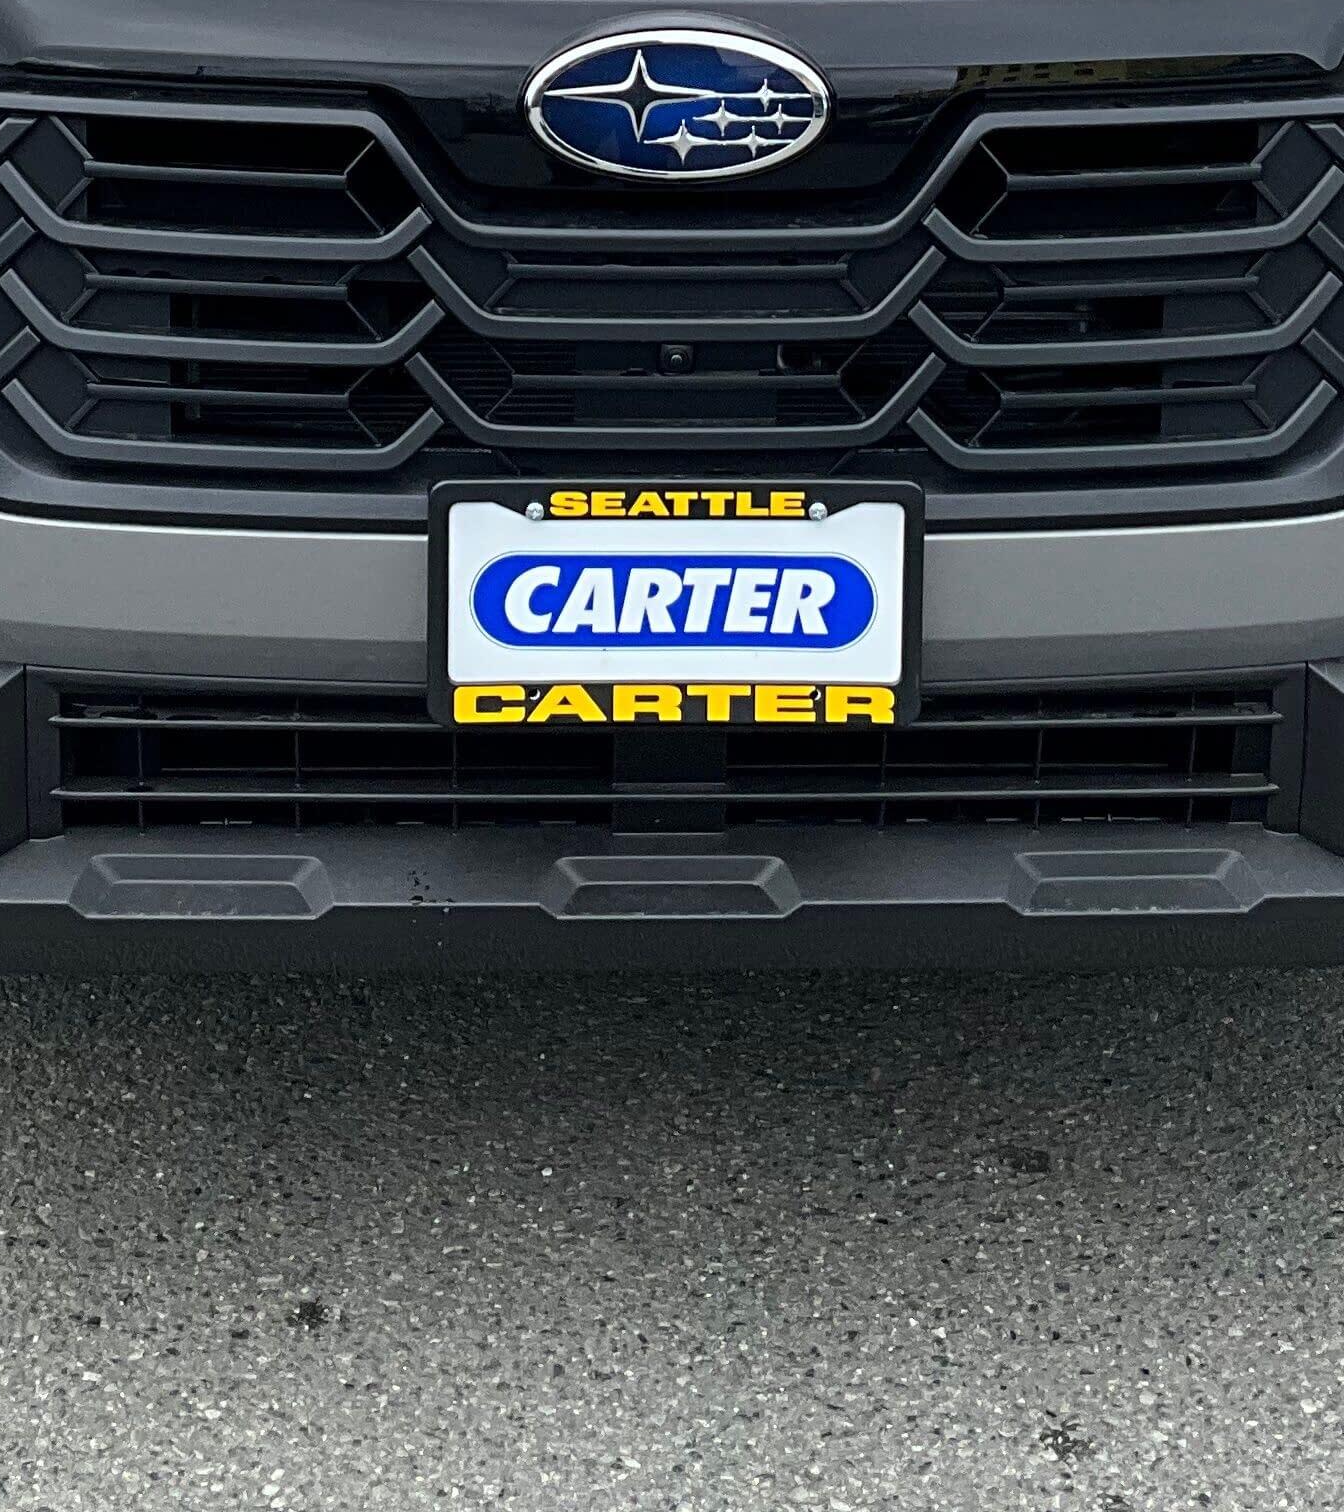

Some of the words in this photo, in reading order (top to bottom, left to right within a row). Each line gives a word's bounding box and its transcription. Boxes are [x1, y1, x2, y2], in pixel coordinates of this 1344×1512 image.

[549, 491, 806, 518] SEATTLE
[504, 565, 836, 635] CARTER
[453, 684, 896, 724] CARTER
